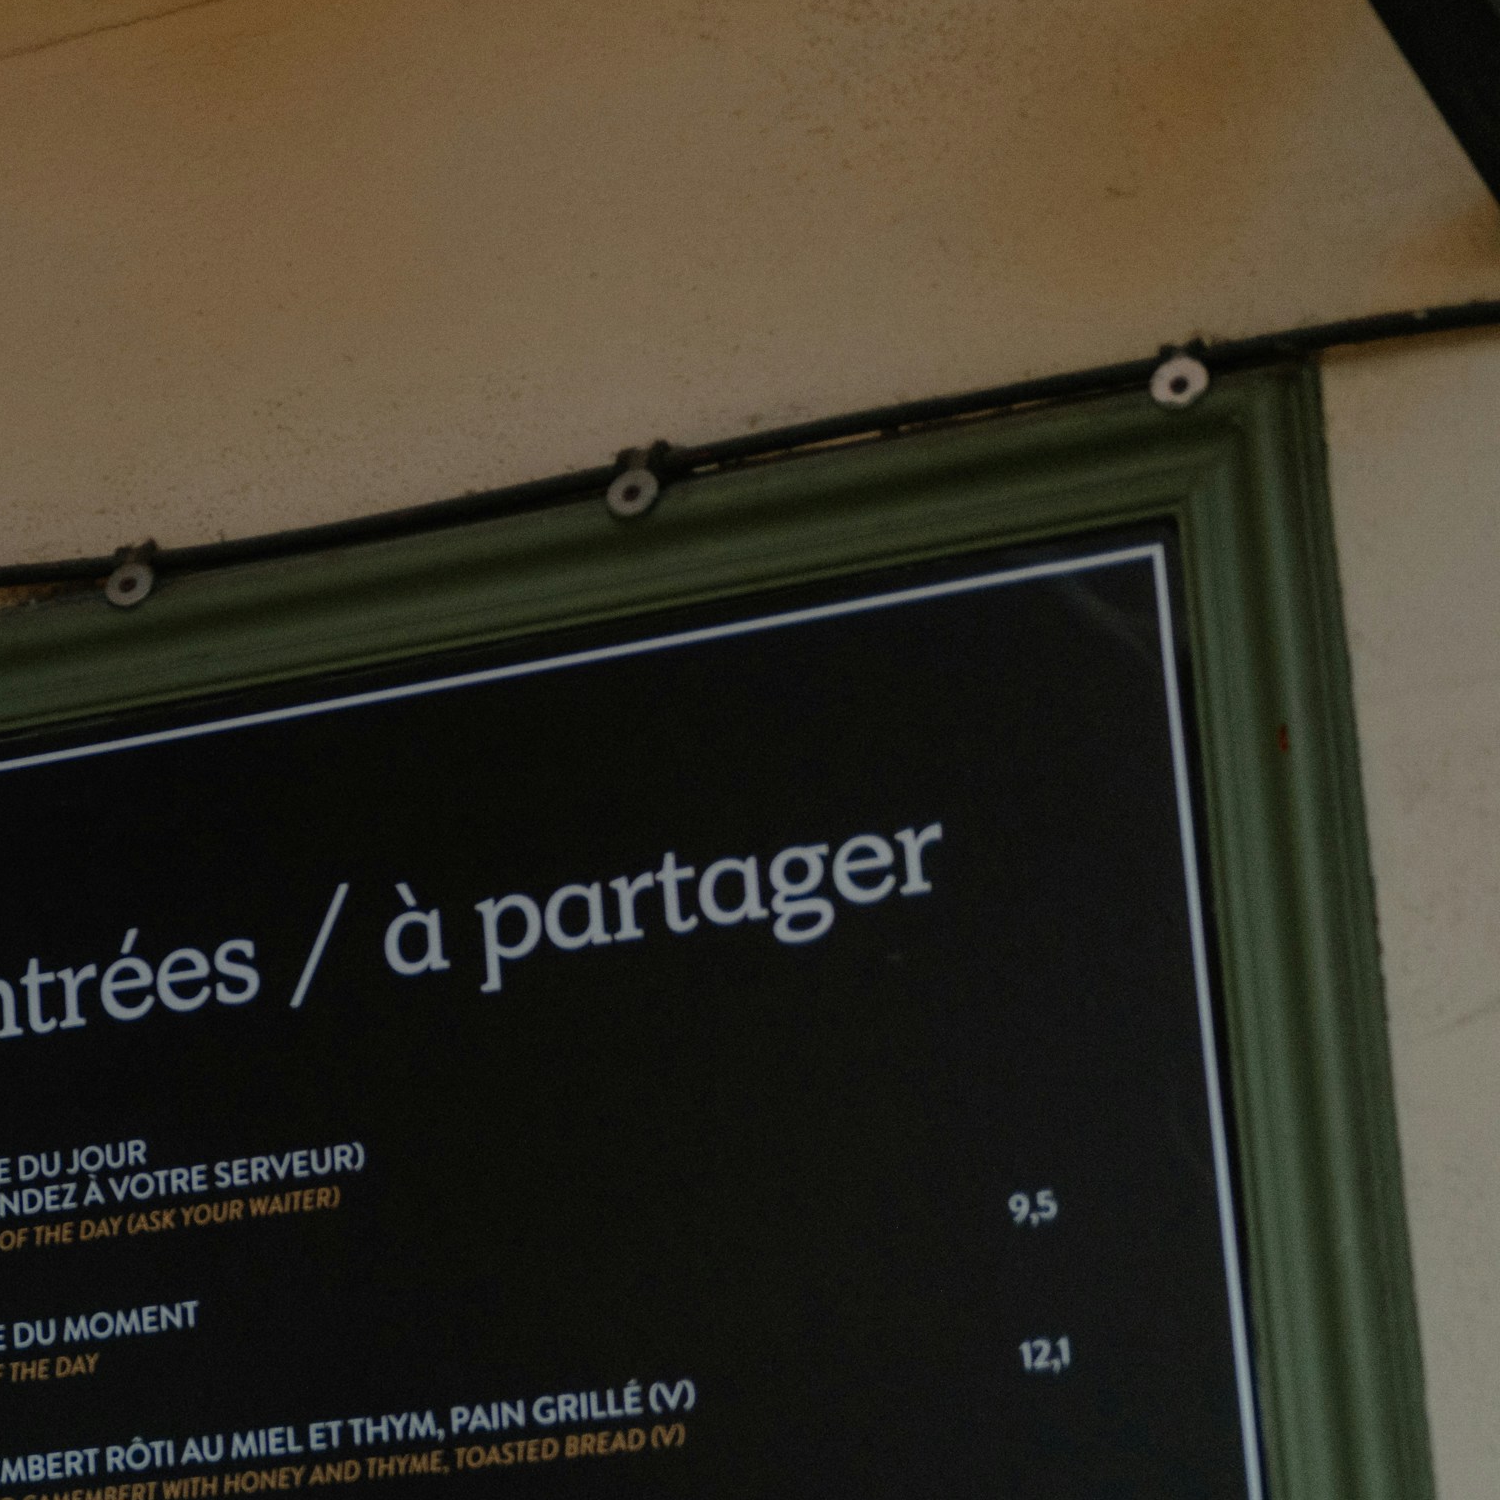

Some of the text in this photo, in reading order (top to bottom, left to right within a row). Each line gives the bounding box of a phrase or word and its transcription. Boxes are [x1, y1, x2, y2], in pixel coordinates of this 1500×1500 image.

[289, 882, 350, 1009] /
[383, 882, 452, 975] à
[474, 822, 944, 994] partager
[17, 1151, 62, 1182] DU
[66, 1139, 147, 1180] JOUR
[83, 1173, 105, 1206] À
[108, 1164, 208, 1202] VOTRE
[214, 1141, 366, 1189] SERVEUR)
[33, 1221, 74, 1246] THE
[78, 1216, 124, 1242] DAY
[126, 1208, 177, 1235] (ASK
[182, 1198, 246, 1227] YOUR
[248, 1185, 342, 1218] WAITER)
[1007, 1188, 1058, 1226] 9,5
[12, 1318, 57, 1349] DU
[63, 1300, 199, 1342] MOMENT
[10, 1357, 49, 1382] THE
[54, 1352, 99, 1379] DAY
[1019, 1336, 1071, 1373] 12,1
[105, 1436, 175, 1473] RÔTI
[180, 1434, 225, 1465] AU
[230, 1426, 304, 1459] MIEL
[308, 1419, 343, 1451] ET
[347, 1410, 445, 1445] THYM,
[450, 1399, 526, 1434] PAIN
[531, 1379, 643, 1426] GRILLÉ
[648, 1379, 697, 1414] (V)
[162, 1475, 219, 1500] WITH
[223, 1465, 305, 1493] HONEY
[308, 1459, 362, 1485] AND
[366, 1449, 450, 1478] THYME,
[455, 1437, 561, 1471] TOASTED
[563, 1427, 648, 1459] BREAD
[650, 1423, 687, 1449] (V)
